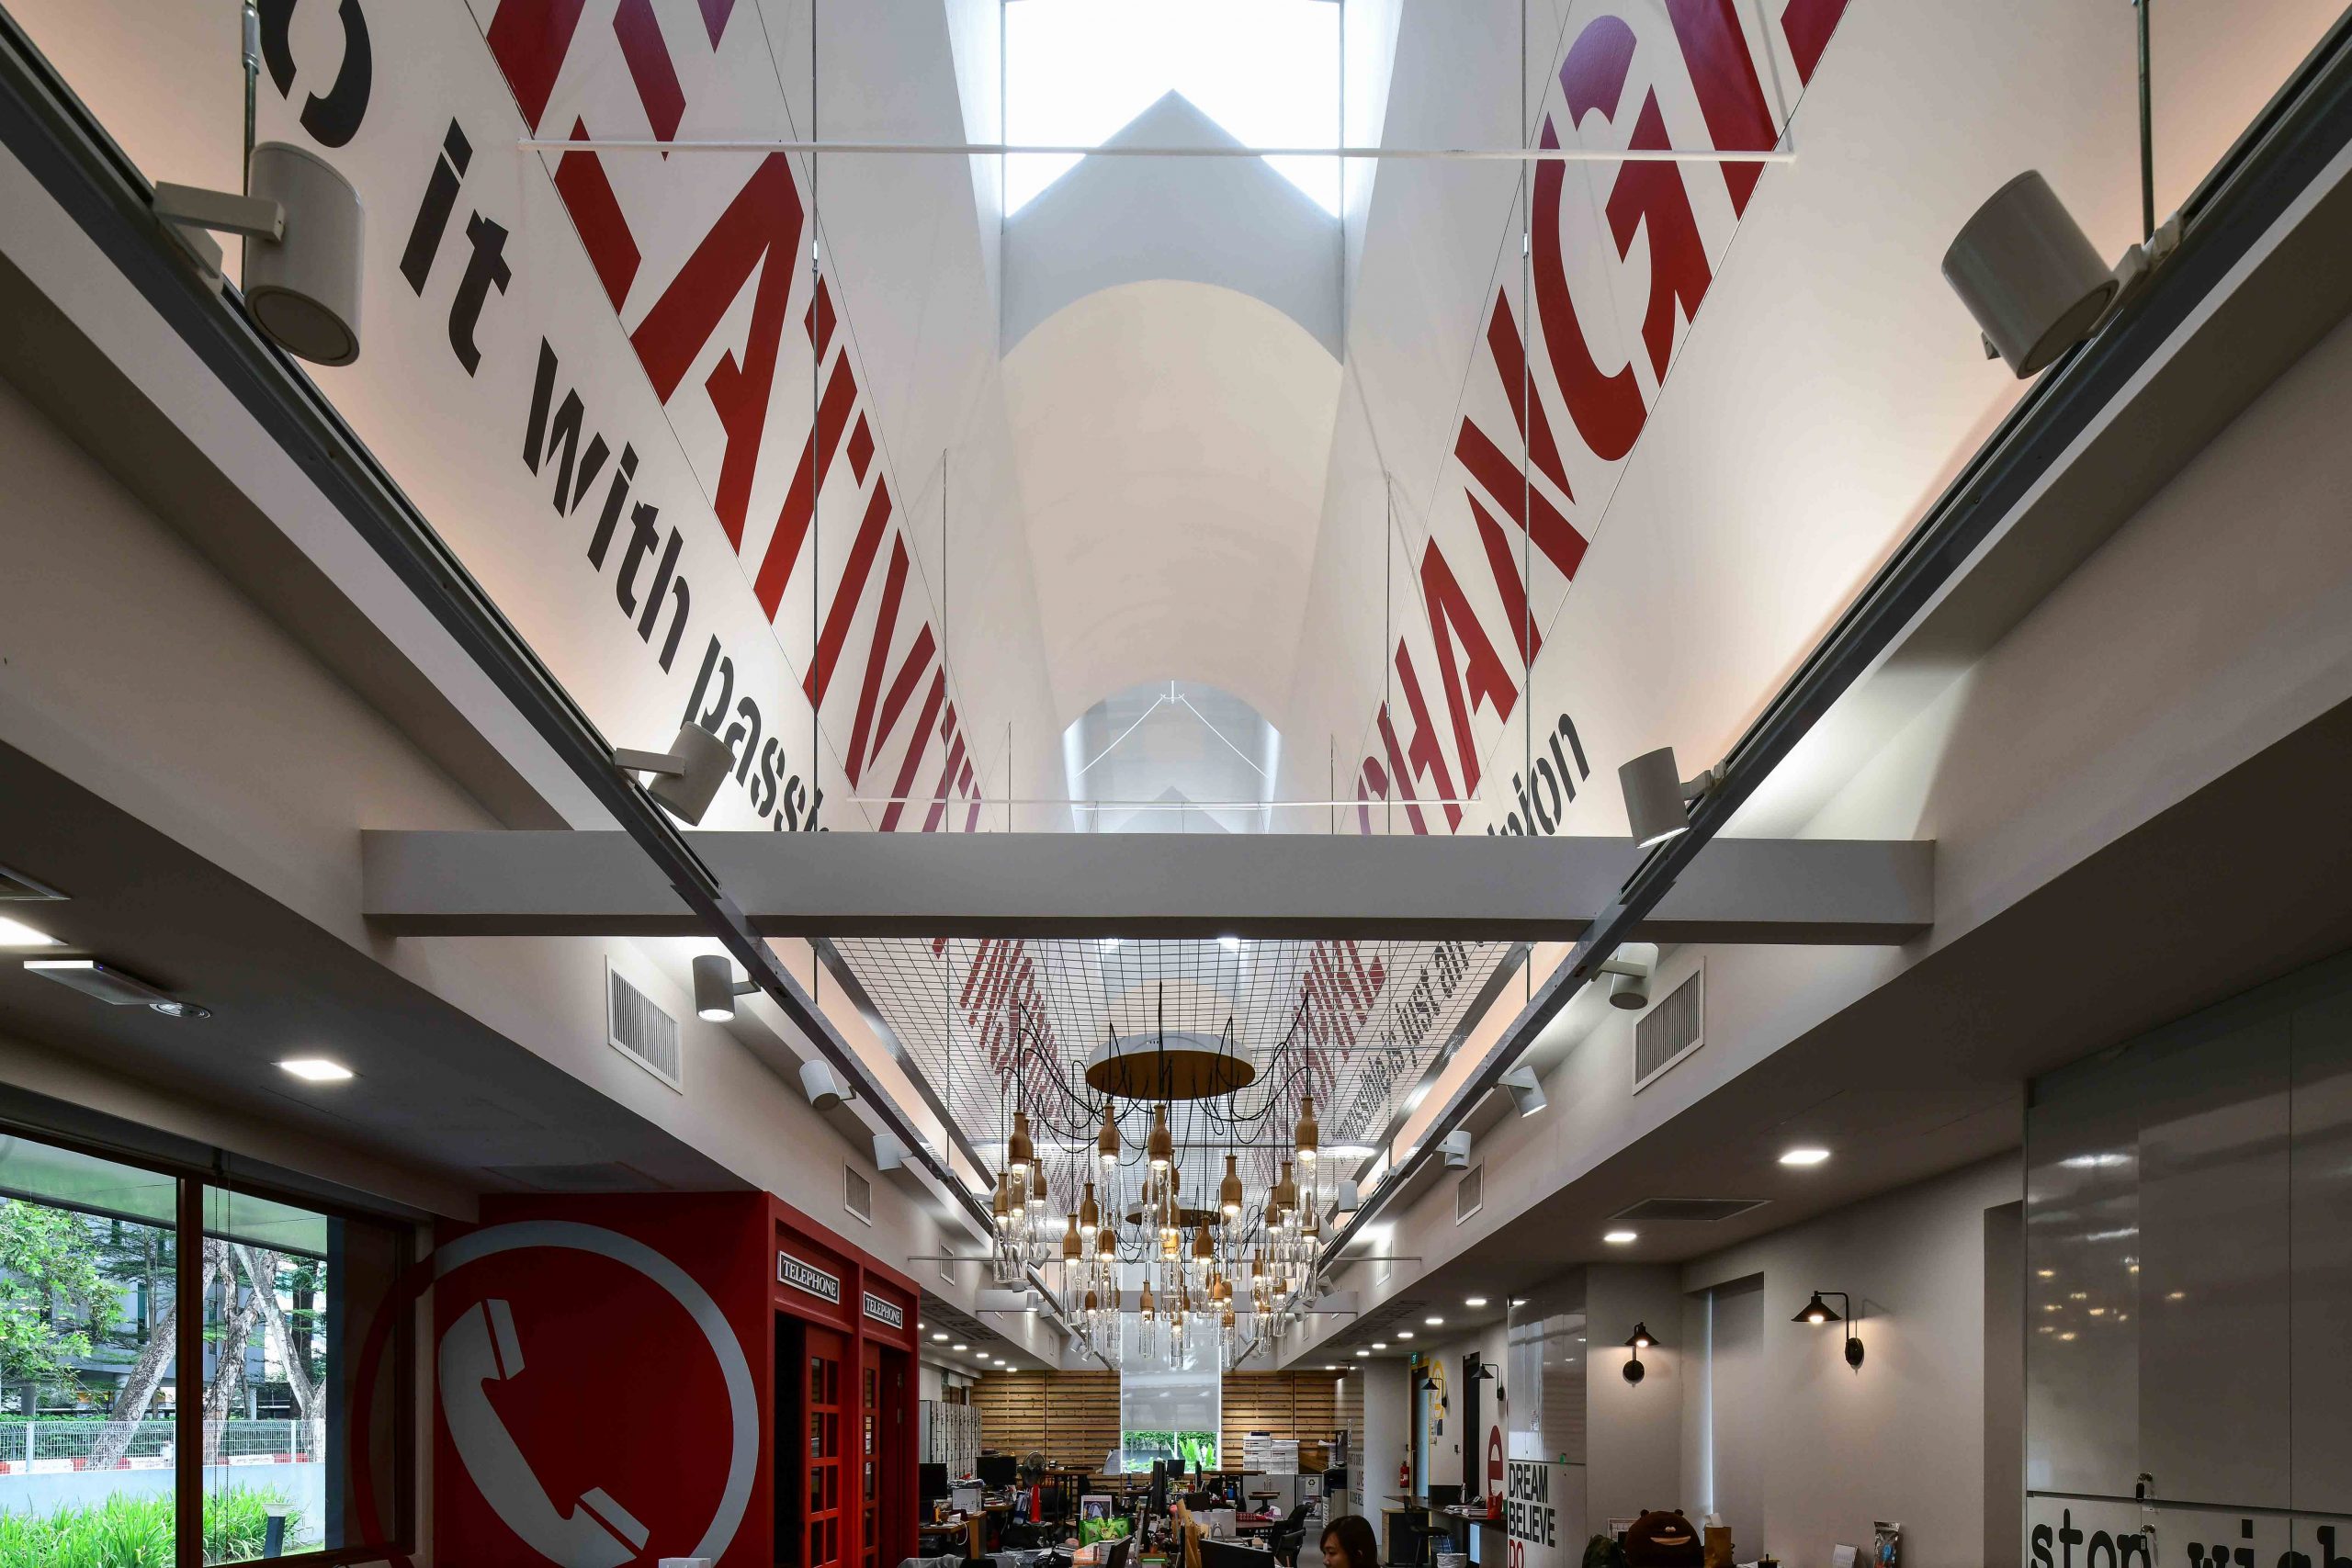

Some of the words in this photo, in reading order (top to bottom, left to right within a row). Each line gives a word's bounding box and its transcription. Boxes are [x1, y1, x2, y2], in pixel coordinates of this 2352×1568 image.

[399, 116, 513, 378] it
[522, 334, 691, 675] with
[783, 1259, 837, 1297] TELEPHONE
[865, 1298, 900, 1325] TELEPHONE
[1509, 1463, 1548, 1504] DREAM
[1509, 1501, 1555, 1548] BELIEVE
